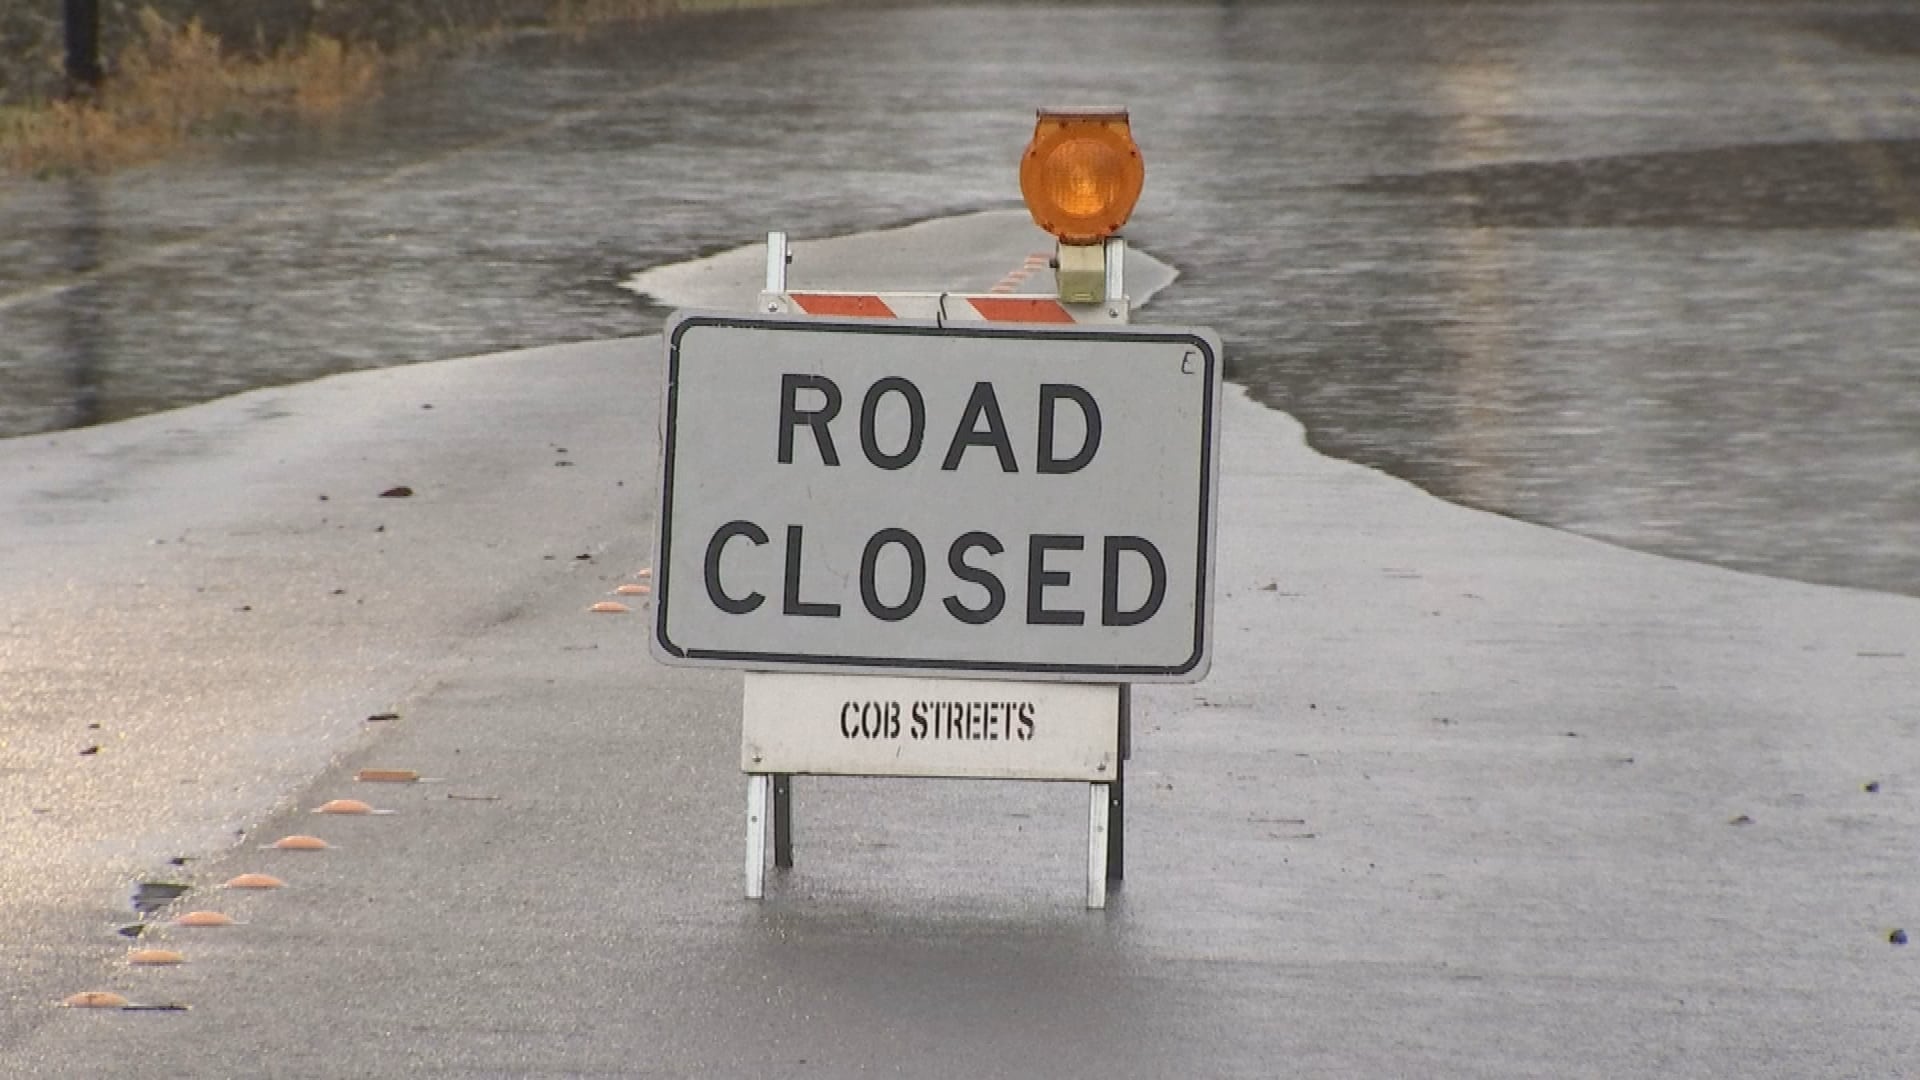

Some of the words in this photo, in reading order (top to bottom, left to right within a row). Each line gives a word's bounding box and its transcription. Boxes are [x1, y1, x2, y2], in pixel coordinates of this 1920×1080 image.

[777, 373, 1103, 475] ROAD
[703, 519, 1168, 627] CLOSED
[840, 701, 901, 740] COB
[910, 701, 1036, 741] STREETS
